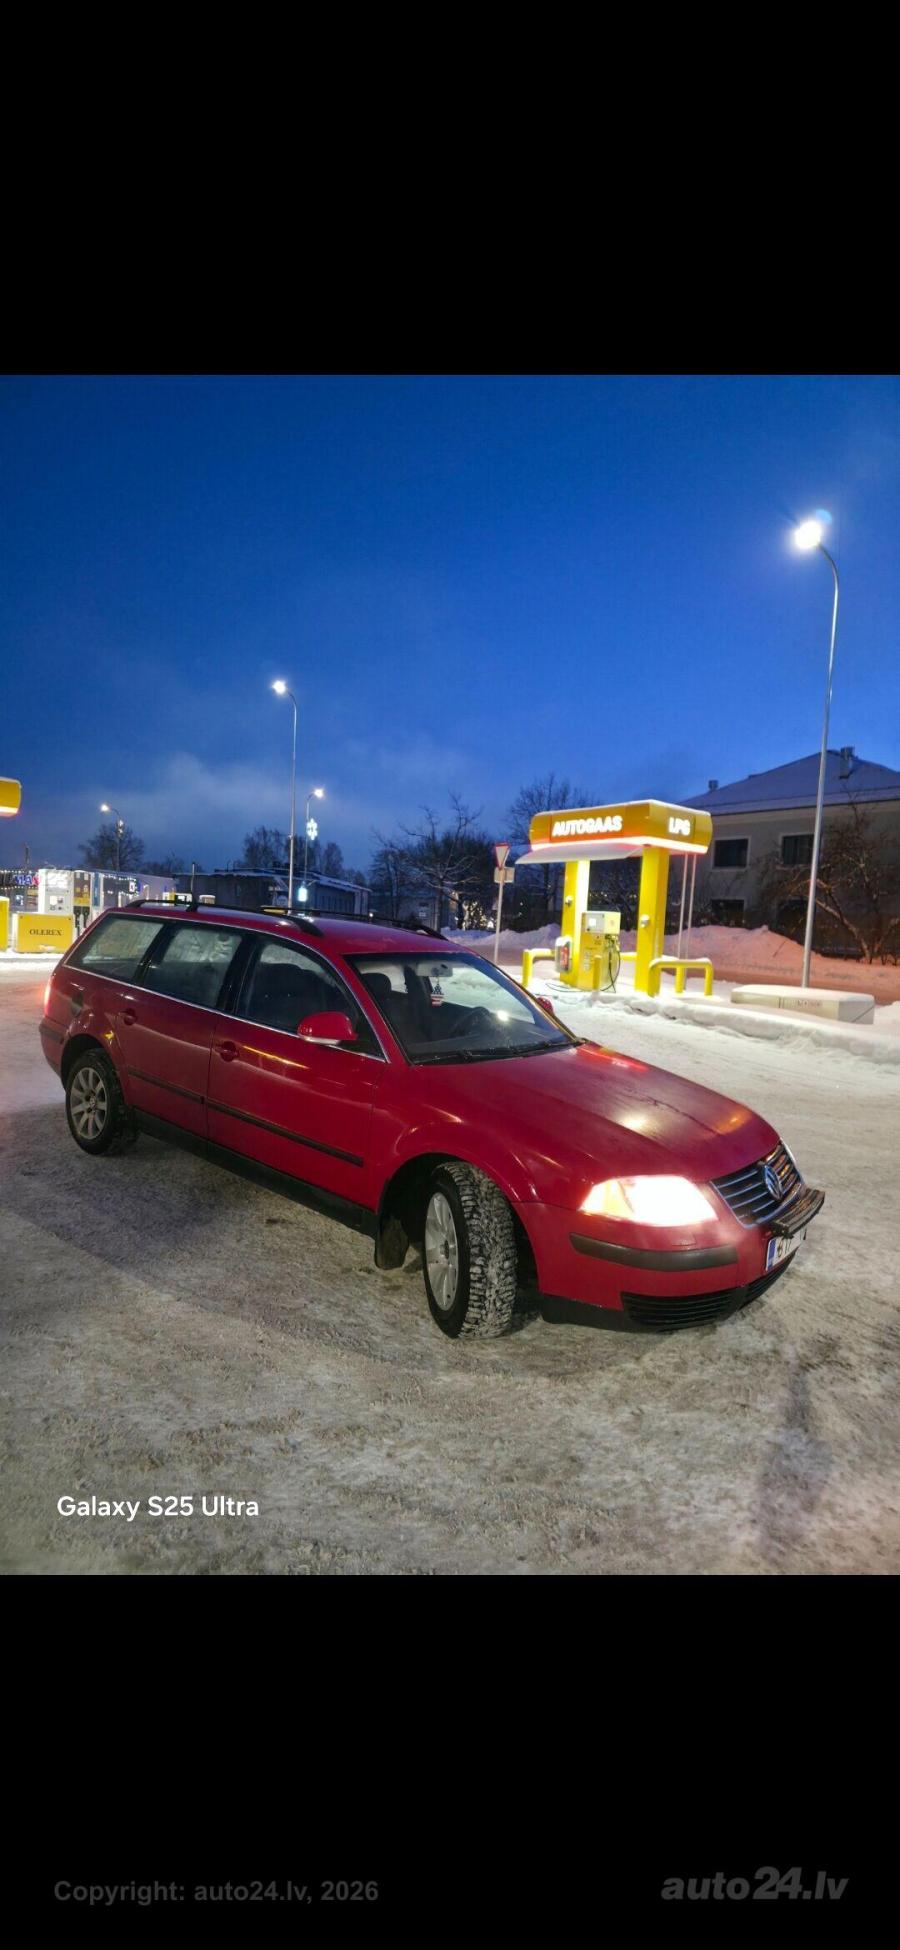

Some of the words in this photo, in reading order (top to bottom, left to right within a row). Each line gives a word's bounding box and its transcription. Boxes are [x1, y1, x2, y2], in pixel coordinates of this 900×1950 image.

[552, 815, 623, 837] AUTOGAAS
[668, 817, 691, 836] LPG
[29, 928, 62, 937] OLEREX
